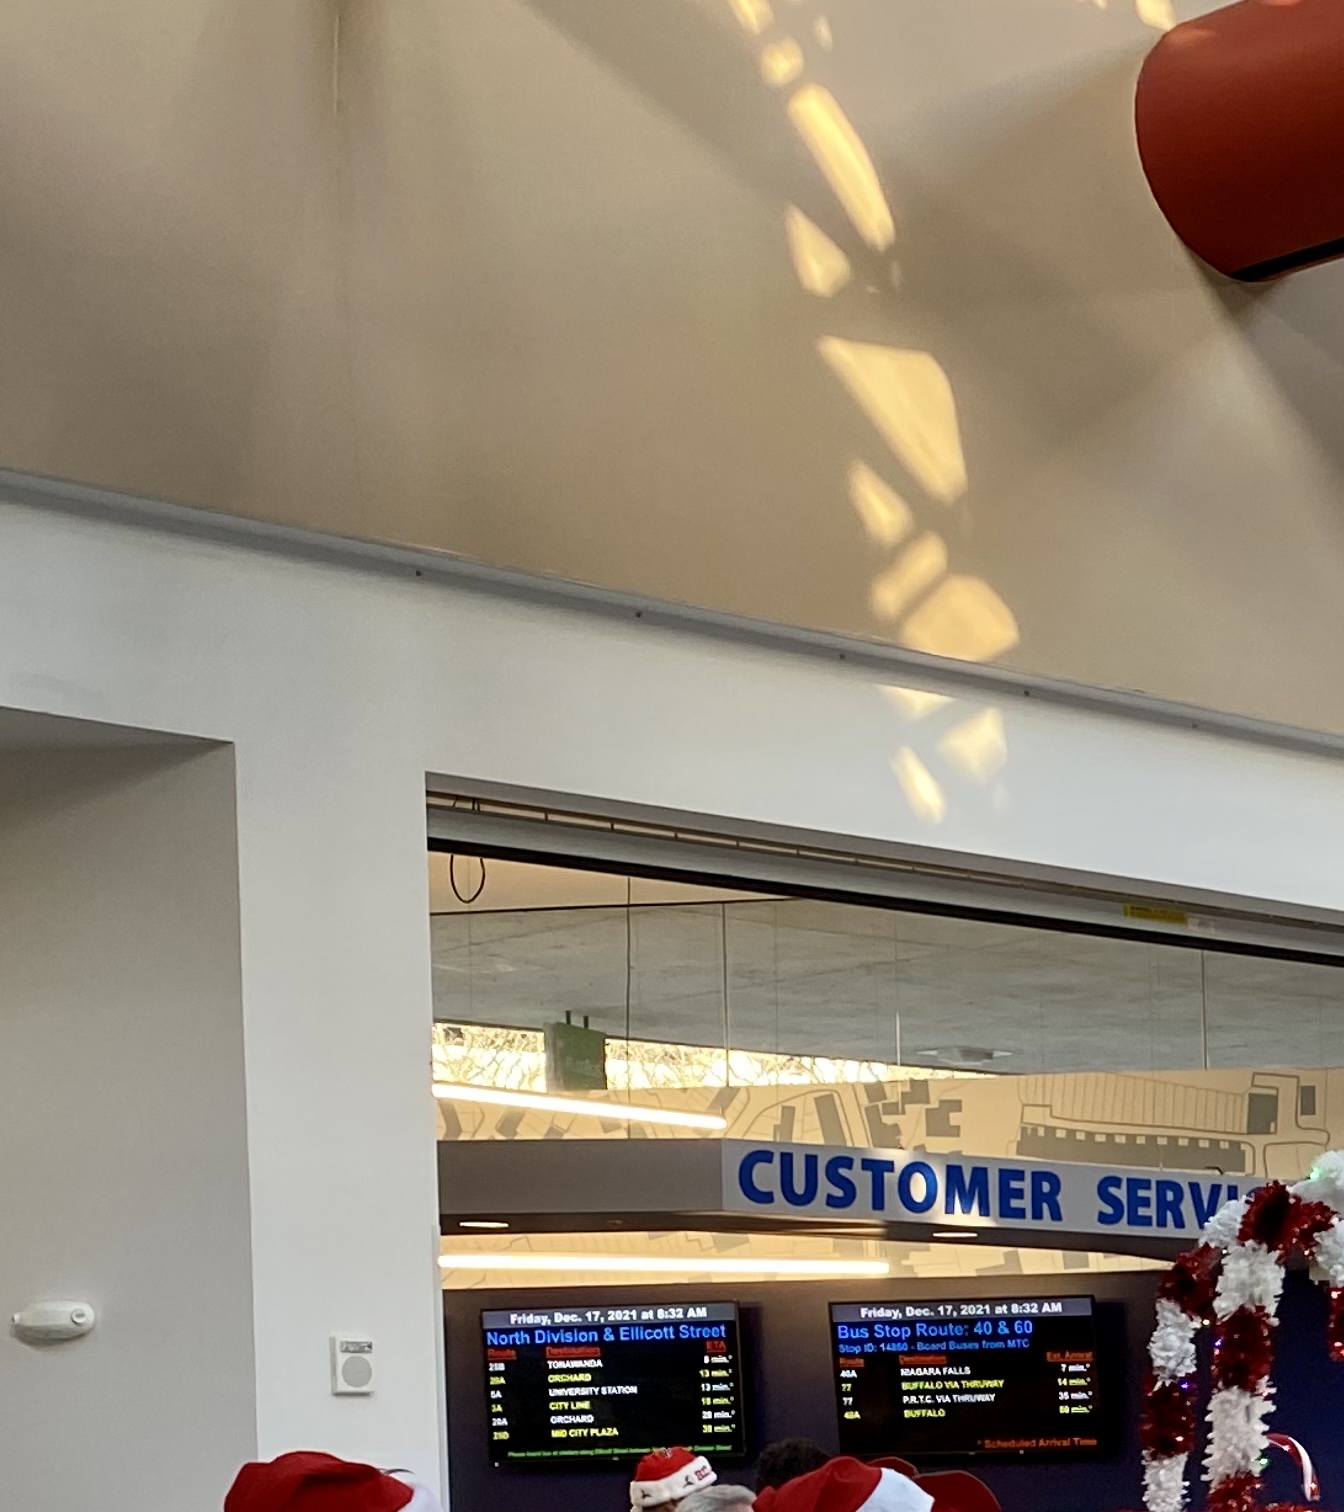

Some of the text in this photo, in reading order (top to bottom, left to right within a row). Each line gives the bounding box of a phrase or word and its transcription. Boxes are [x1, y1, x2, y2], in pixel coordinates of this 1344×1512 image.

[738, 1149, 1266, 1230] CUSTOMER SERV
[861, 1302, 1063, 1319] Friday, Dec. 17, 2021 at 8:32 AM
[510, 1307, 707, 1326] Friday, Dec. 17, 2021 at 8:32 AM
[486, 1324, 727, 1346] North Division & Ellicott Street
[837, 1320, 1033, 1340] Bus Stop Route: 40 & 60
[706, 1340, 727, 1352] ETA
[838, 1344, 861, 1354] Stop
[863, 1343, 877, 1352] ID:
[916, 1341, 946, 1351] Board
[949, 1341, 979, 1350] Buses
[981, 1340, 1005, 1349] from
[1007, 1338, 1030, 1348] MTC
[547, 1360, 603, 1369] TONAWANDA
[900, 1367, 941, 1377] NIAGARA
[943, 1366, 971, 1375] FALLS
[548, 1373, 592, 1383] ORCHARD
[901, 1381, 943, 1391] BUFFALO
[944, 1380, 959, 1389] VIA
[961, 1379, 1005, 1388] THRUWAY
[548, 1388, 600, 1396] UNIVERSITY
[601, 1386, 638, 1395] STATION
[935, 1394, 951, 1403] VIA
[952, 1393, 996, 1402] THRUWAY
[549, 1402, 569, 1410] CITY
[571, 1401, 591, 1410] LINE
[903, 1409, 946, 1418] BUFFALO
[550, 1415, 595, 1424] ORCHARD
[569, 1429, 589, 1437] CITY
[590, 1427, 619, 1436] PLAZA
[984, 1437, 1097, 1449] Scheduled Arrival Time
